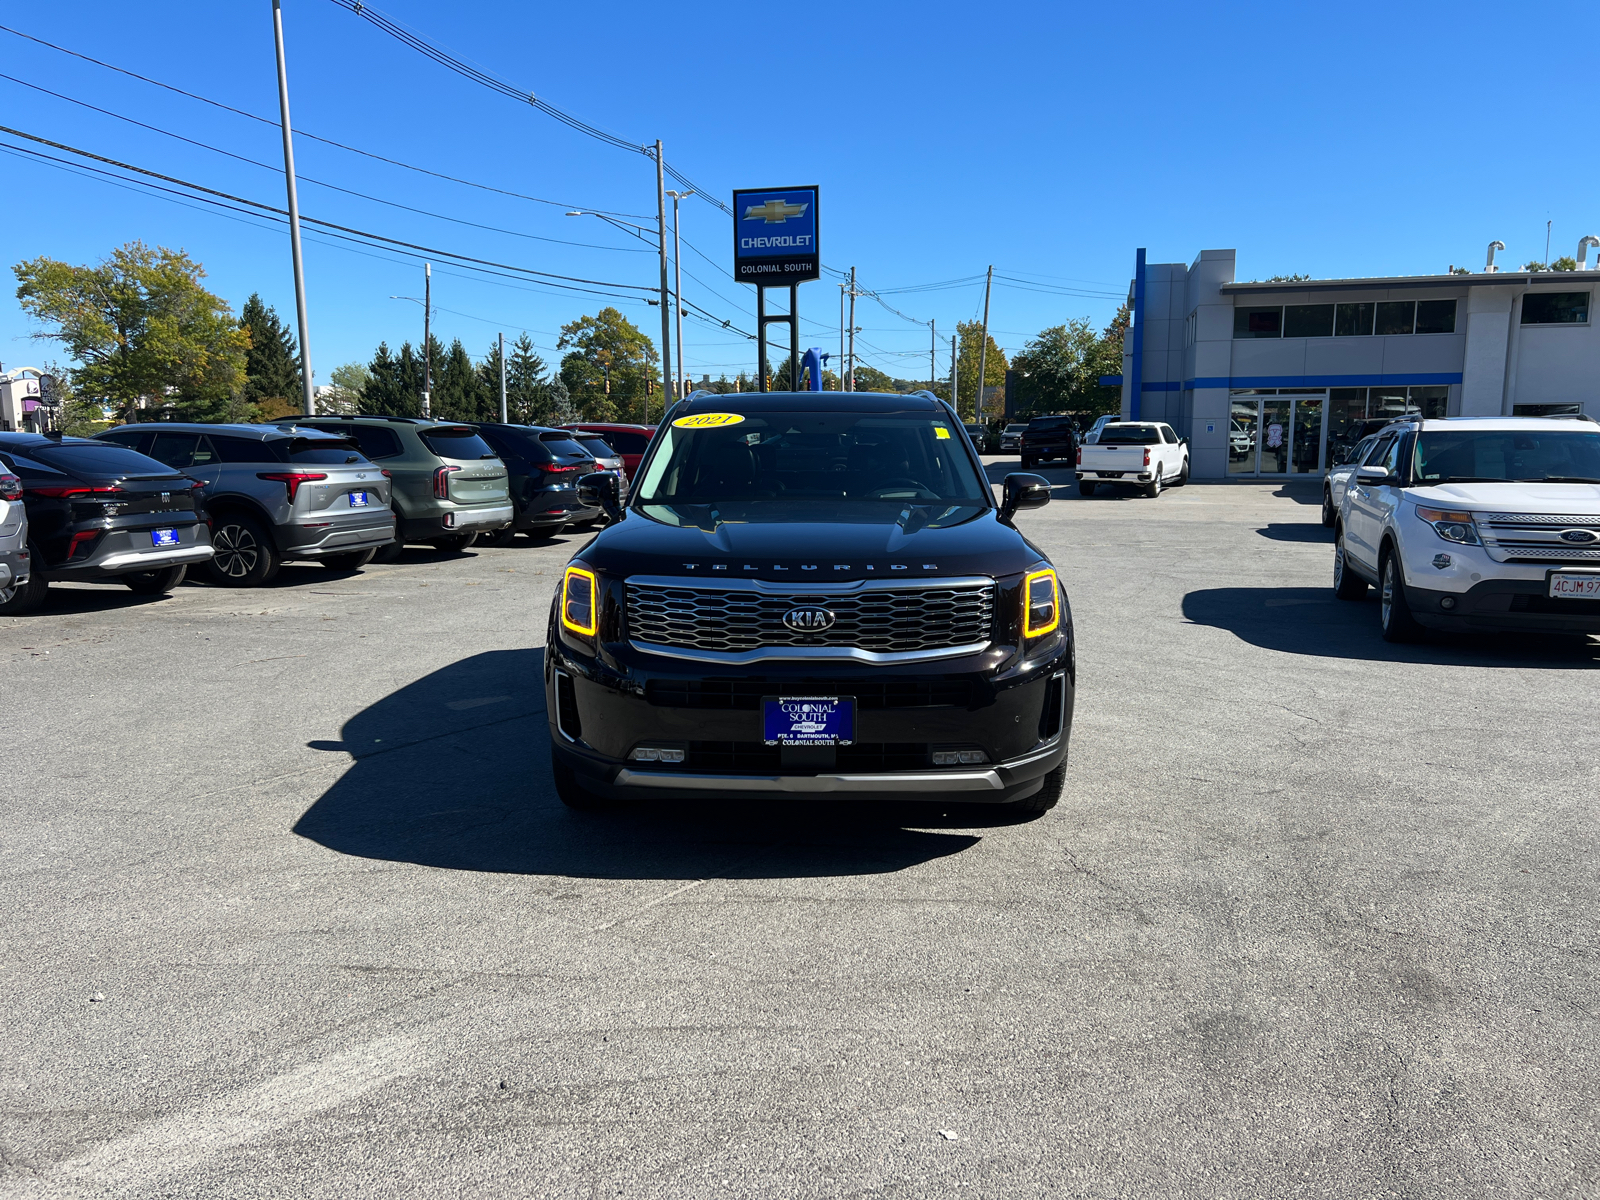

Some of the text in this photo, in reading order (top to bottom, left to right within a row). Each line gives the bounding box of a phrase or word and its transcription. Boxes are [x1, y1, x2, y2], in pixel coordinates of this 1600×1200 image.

[741, 235, 812, 249] CHEVROLET
[741, 263, 812, 274] COLONIAL SOUTH
[683, 415, 733, 426] 2021
[1568, 532, 1590, 541] Ford
[682, 563, 938, 571] TELLURIDE
[1553, 580, 1584, 593] 4CJM
[791, 611, 827, 627] KIA
[781, 703, 836, 713] COLONIAL
[789, 713, 827, 722] SOUTH
